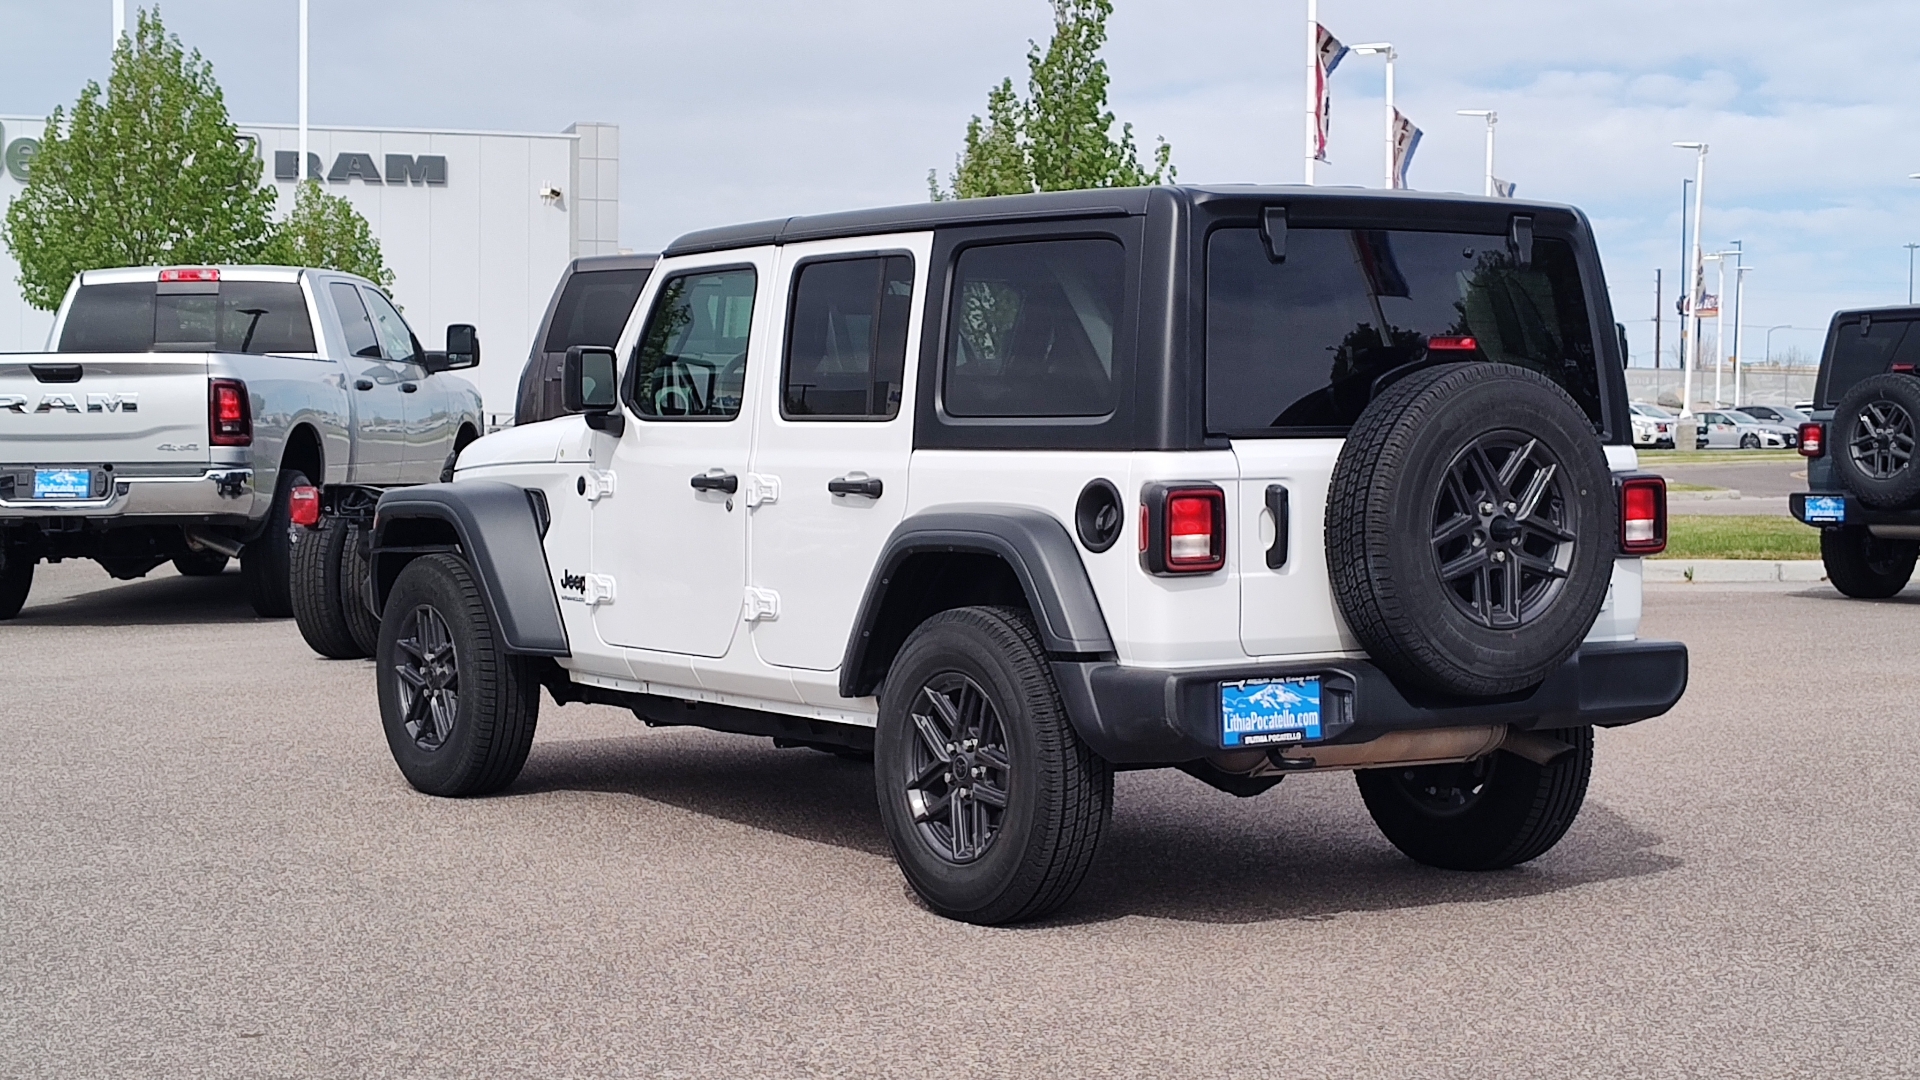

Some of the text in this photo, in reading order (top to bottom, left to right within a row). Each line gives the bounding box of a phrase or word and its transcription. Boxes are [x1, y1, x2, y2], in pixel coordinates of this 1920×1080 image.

[274, 150, 446, 183] RAM
[561, 569, 585, 595] Jeep
[1224, 710, 1318, 732] LithiaPocatello.com
